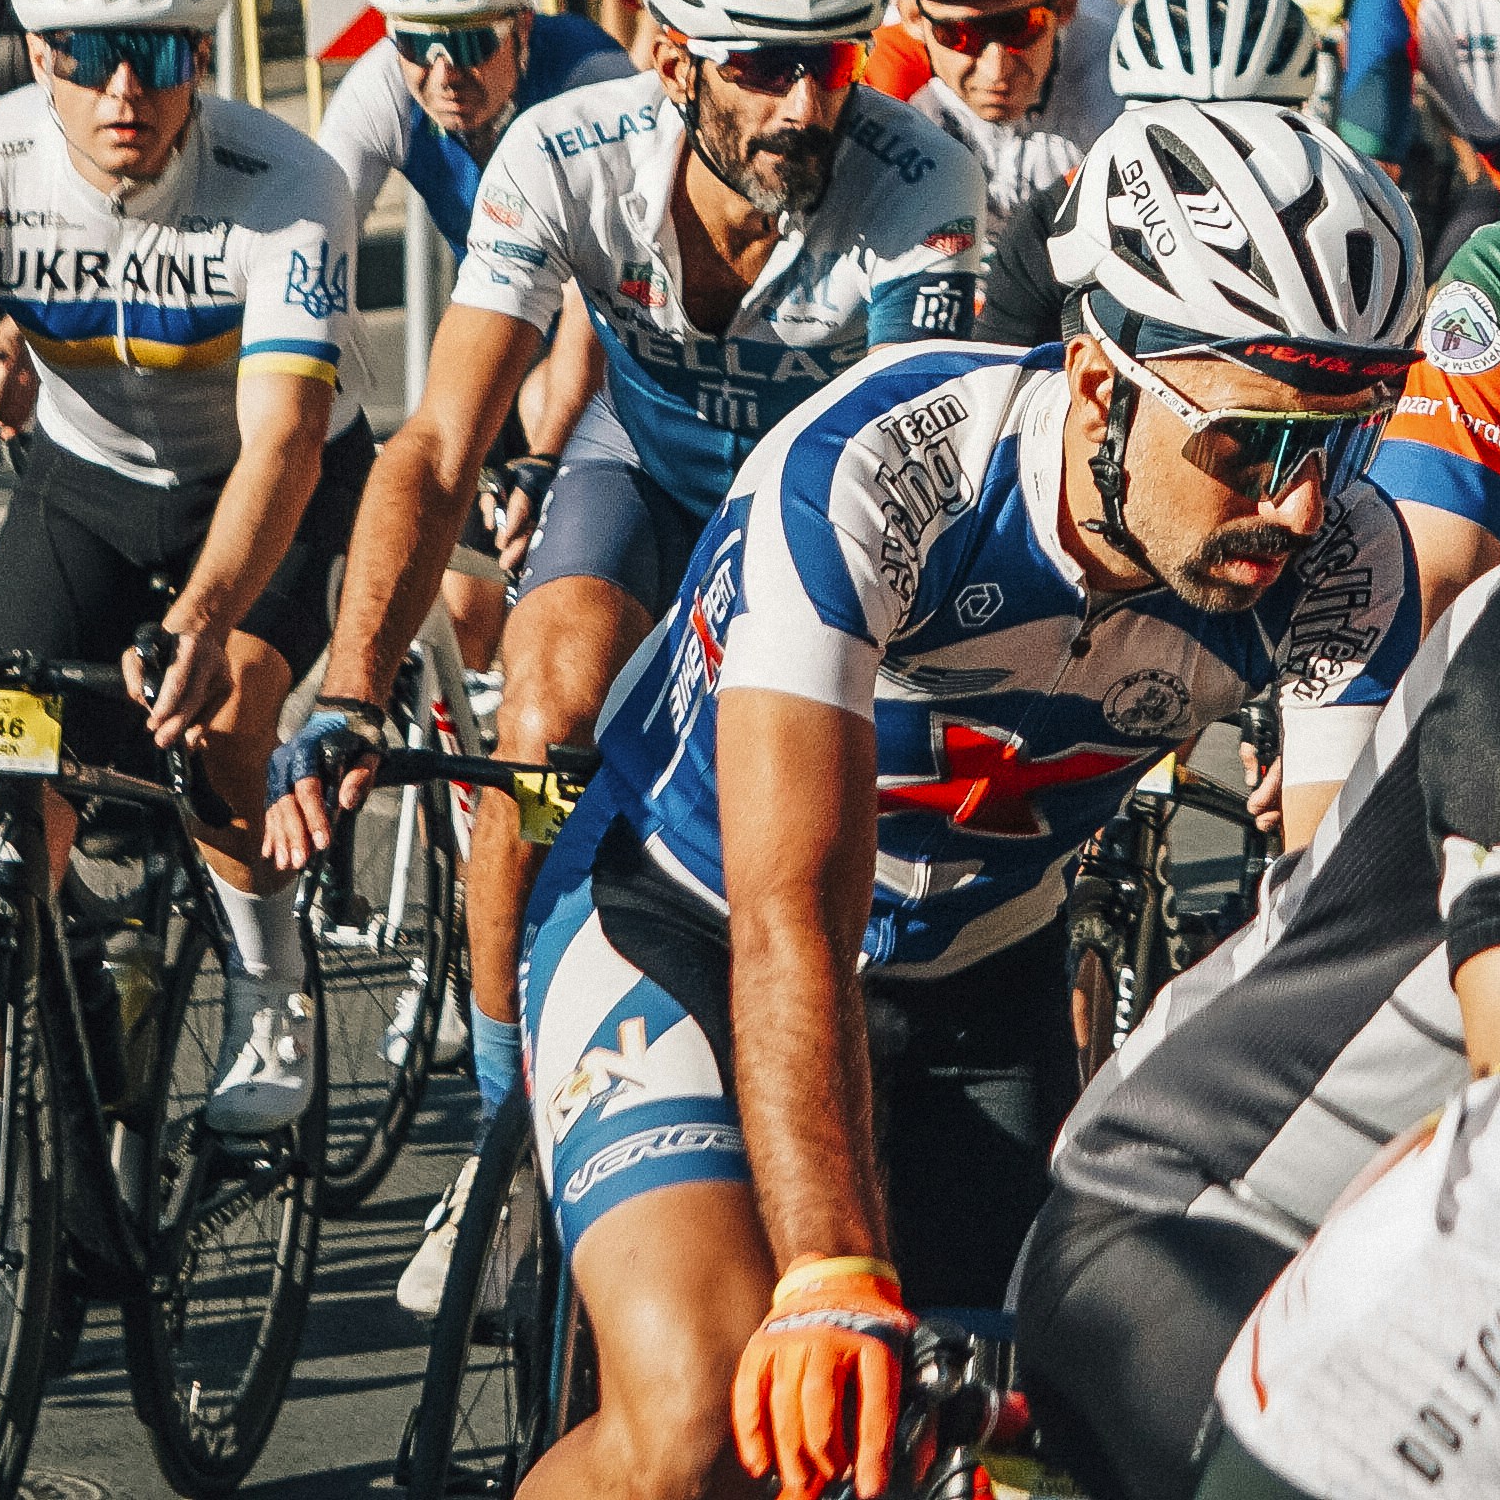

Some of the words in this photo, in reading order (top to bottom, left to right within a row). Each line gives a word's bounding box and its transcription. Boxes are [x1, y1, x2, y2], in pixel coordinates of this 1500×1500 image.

[537, 104, 658, 162] HELLAS
[1120, 158, 1178, 258] BRIKO
[876, 394, 969, 456] Team
